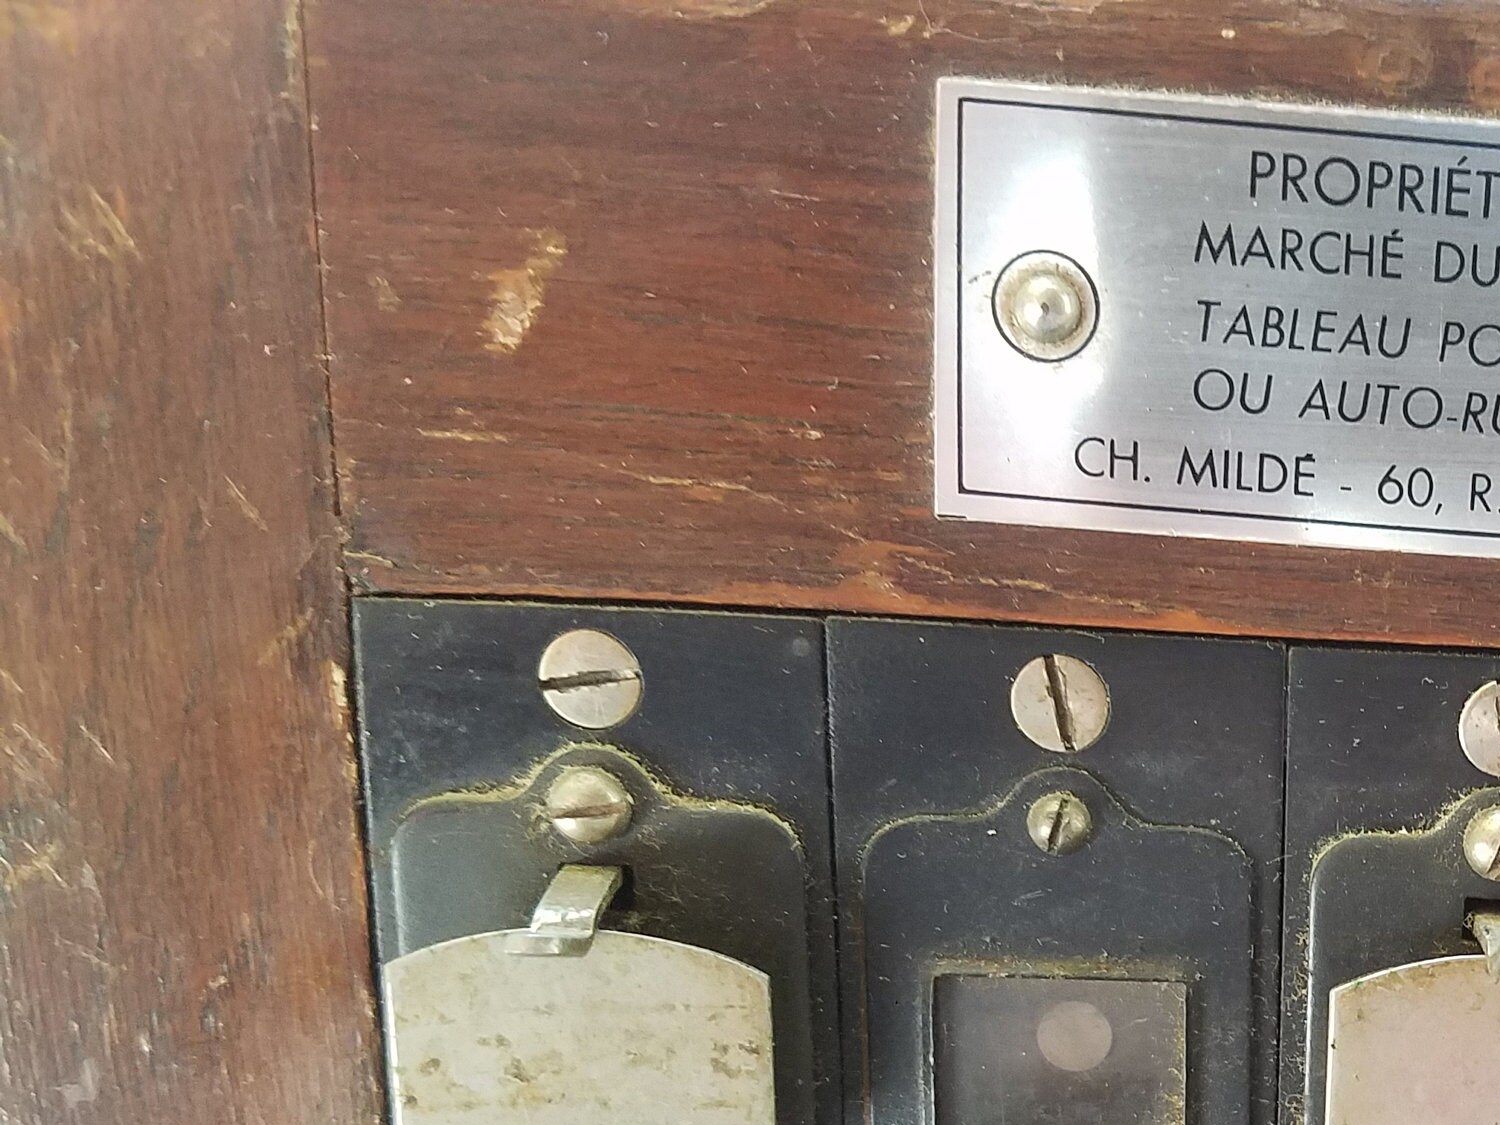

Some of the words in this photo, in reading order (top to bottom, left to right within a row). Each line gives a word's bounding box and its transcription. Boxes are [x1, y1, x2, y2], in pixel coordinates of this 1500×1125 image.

[1193, 220, 1404, 280] MARCHÉ
[1196, 299, 1412, 359] TABLEAU
[1193, 368, 1273, 415] OU
[1074, 436, 1151, 483] CH.
[1176, 445, 1316, 497] MILDÉ
[1377, 464, 1443, 516] 60,
